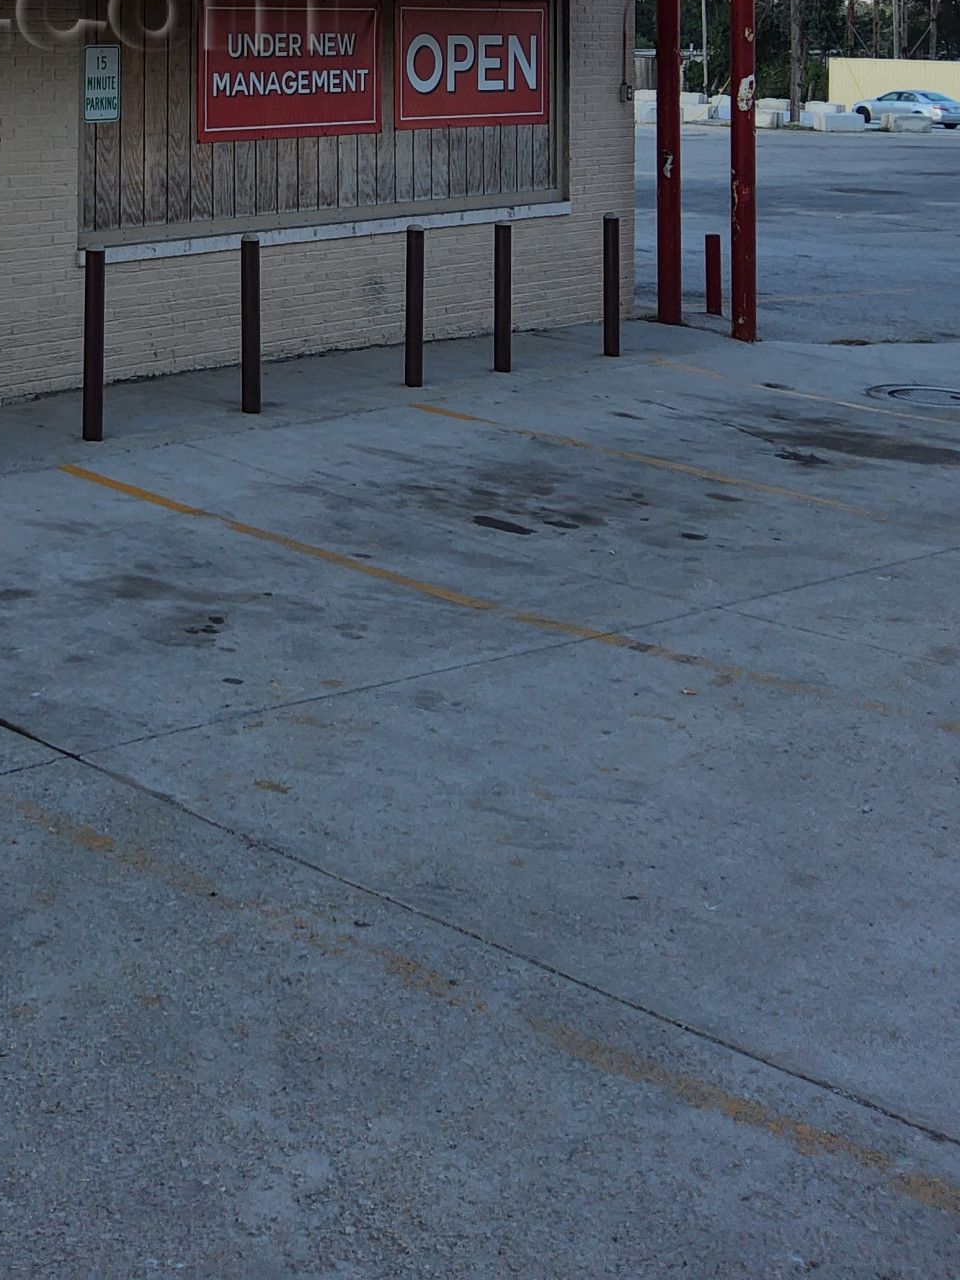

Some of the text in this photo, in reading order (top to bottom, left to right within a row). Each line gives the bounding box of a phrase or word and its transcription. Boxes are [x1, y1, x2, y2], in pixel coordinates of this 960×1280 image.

[227, 32, 357, 58] UNDER NEW
[96, 55, 108, 71] 15
[405, 33, 538, 95] OPEN
[87, 75, 116, 91] MINUTE
[212, 68, 369, 98] MANAGEMENT
[85, 95, 118, 112] PARKING
